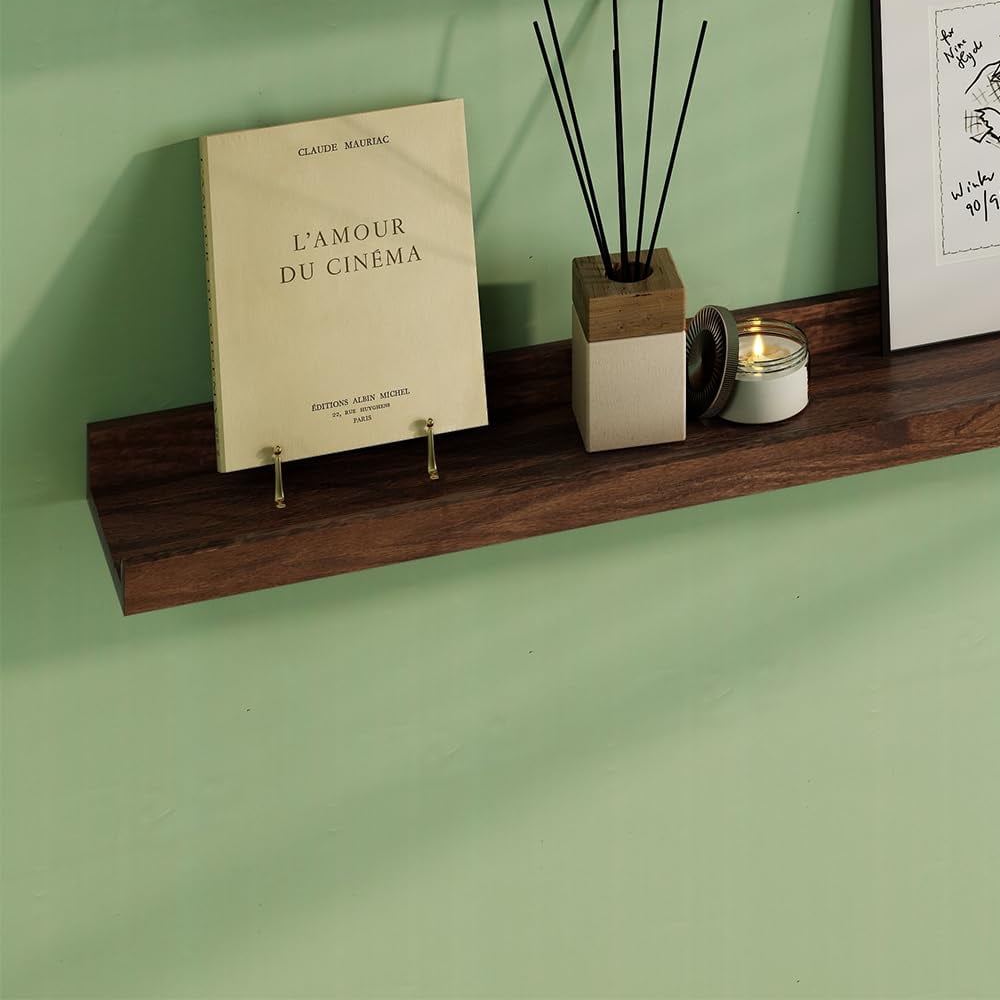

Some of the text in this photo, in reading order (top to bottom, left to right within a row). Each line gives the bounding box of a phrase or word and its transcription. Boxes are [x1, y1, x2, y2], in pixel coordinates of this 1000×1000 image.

[298, 135, 390, 157] CLAUDE MAURIAC
[293, 217, 405, 251] L'AMOUR
[279, 245, 422, 284] DU CINÉMA
[311, 387, 411, 411] ÉDITIONS ALBIN MICHEL
[353, 414, 372, 423] PARIS
